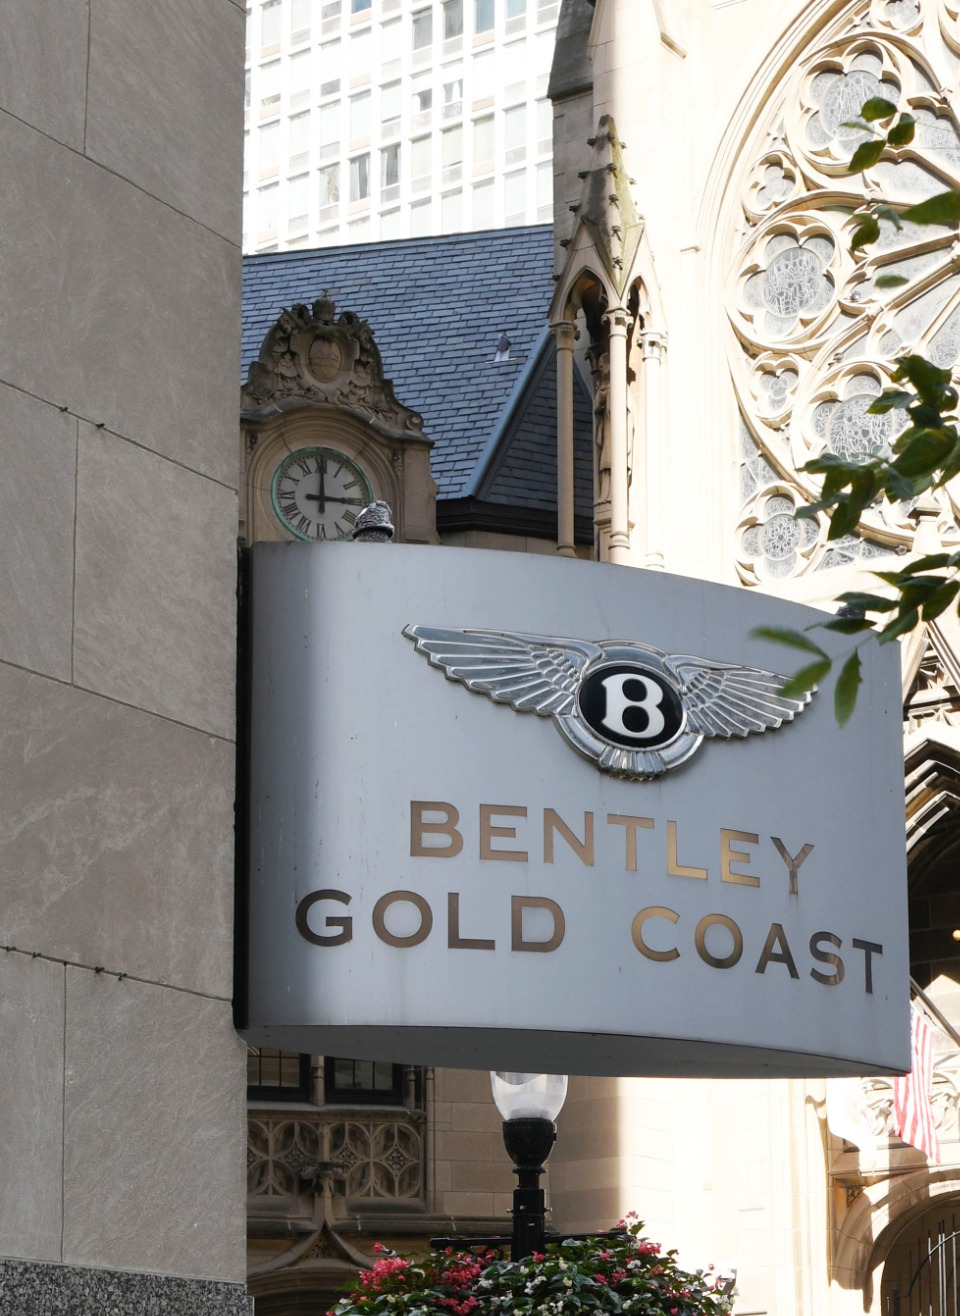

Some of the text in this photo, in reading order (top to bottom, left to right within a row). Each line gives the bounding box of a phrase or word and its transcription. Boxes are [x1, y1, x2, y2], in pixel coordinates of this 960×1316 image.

[600, 672, 666, 739] B
[409, 799, 815, 896] BENTLEY
[295, 889, 884, 995] GOLD COAST
